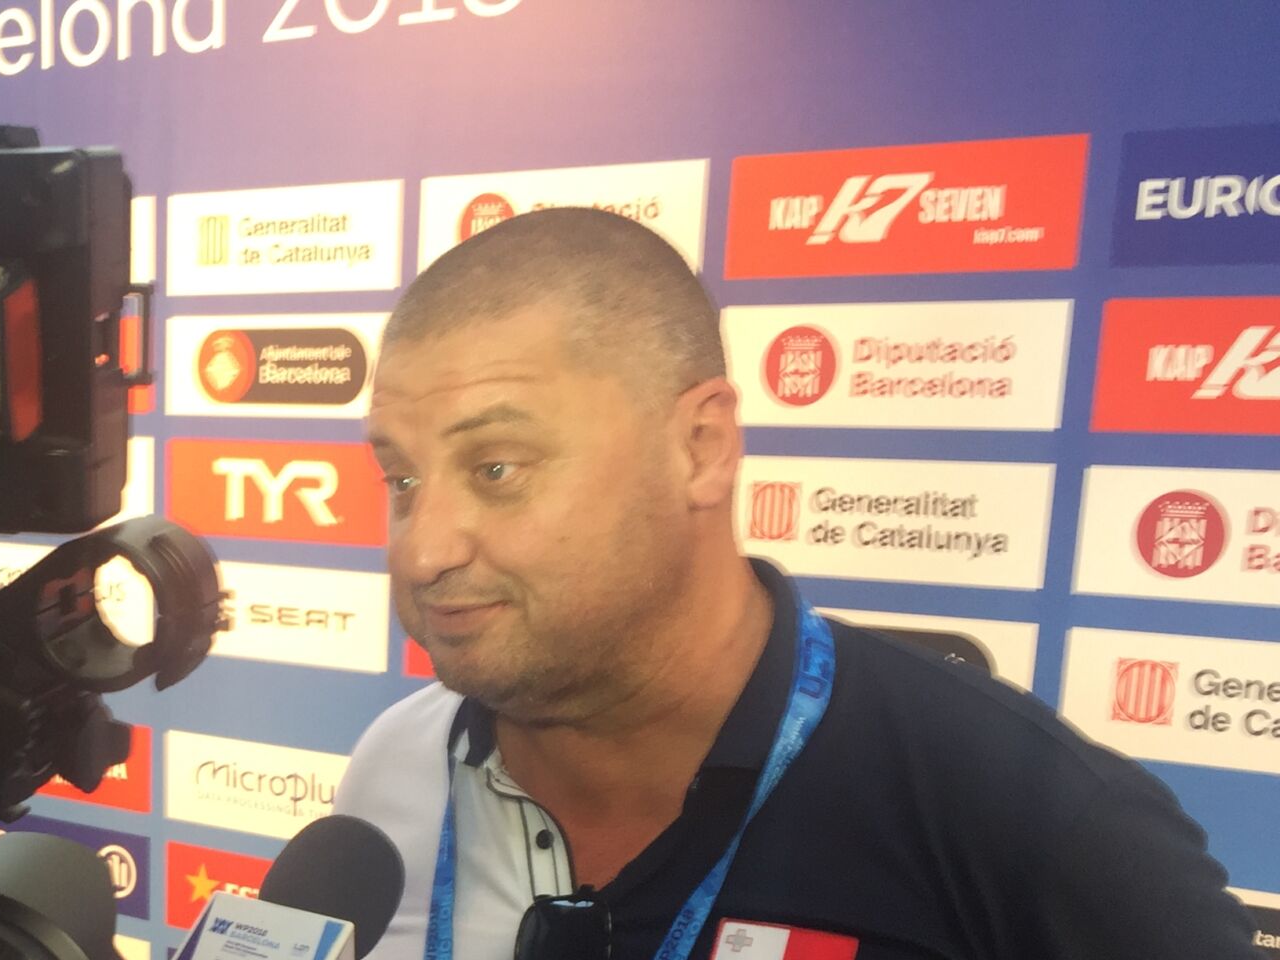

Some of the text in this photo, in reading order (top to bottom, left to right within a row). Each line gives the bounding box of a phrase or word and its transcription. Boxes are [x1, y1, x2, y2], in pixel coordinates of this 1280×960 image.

[768, 195, 822, 231] KAP
[918, 184, 1008, 225] SEVEN
[239, 213, 348, 237] Generalitat
[272, 243, 372, 268] Catalunya
[851, 334, 1018, 367] Diputació
[1145, 344, 1215, 382] KAP
[849, 372, 1013, 400] Barcelona
[212, 457, 339, 527] TYR
[809, 486, 980, 519] Generalitat
[809, 521, 1010, 560] de Catalunya
[250, 603, 357, 632] SEAT
[1184, 703, 1232, 733] de
